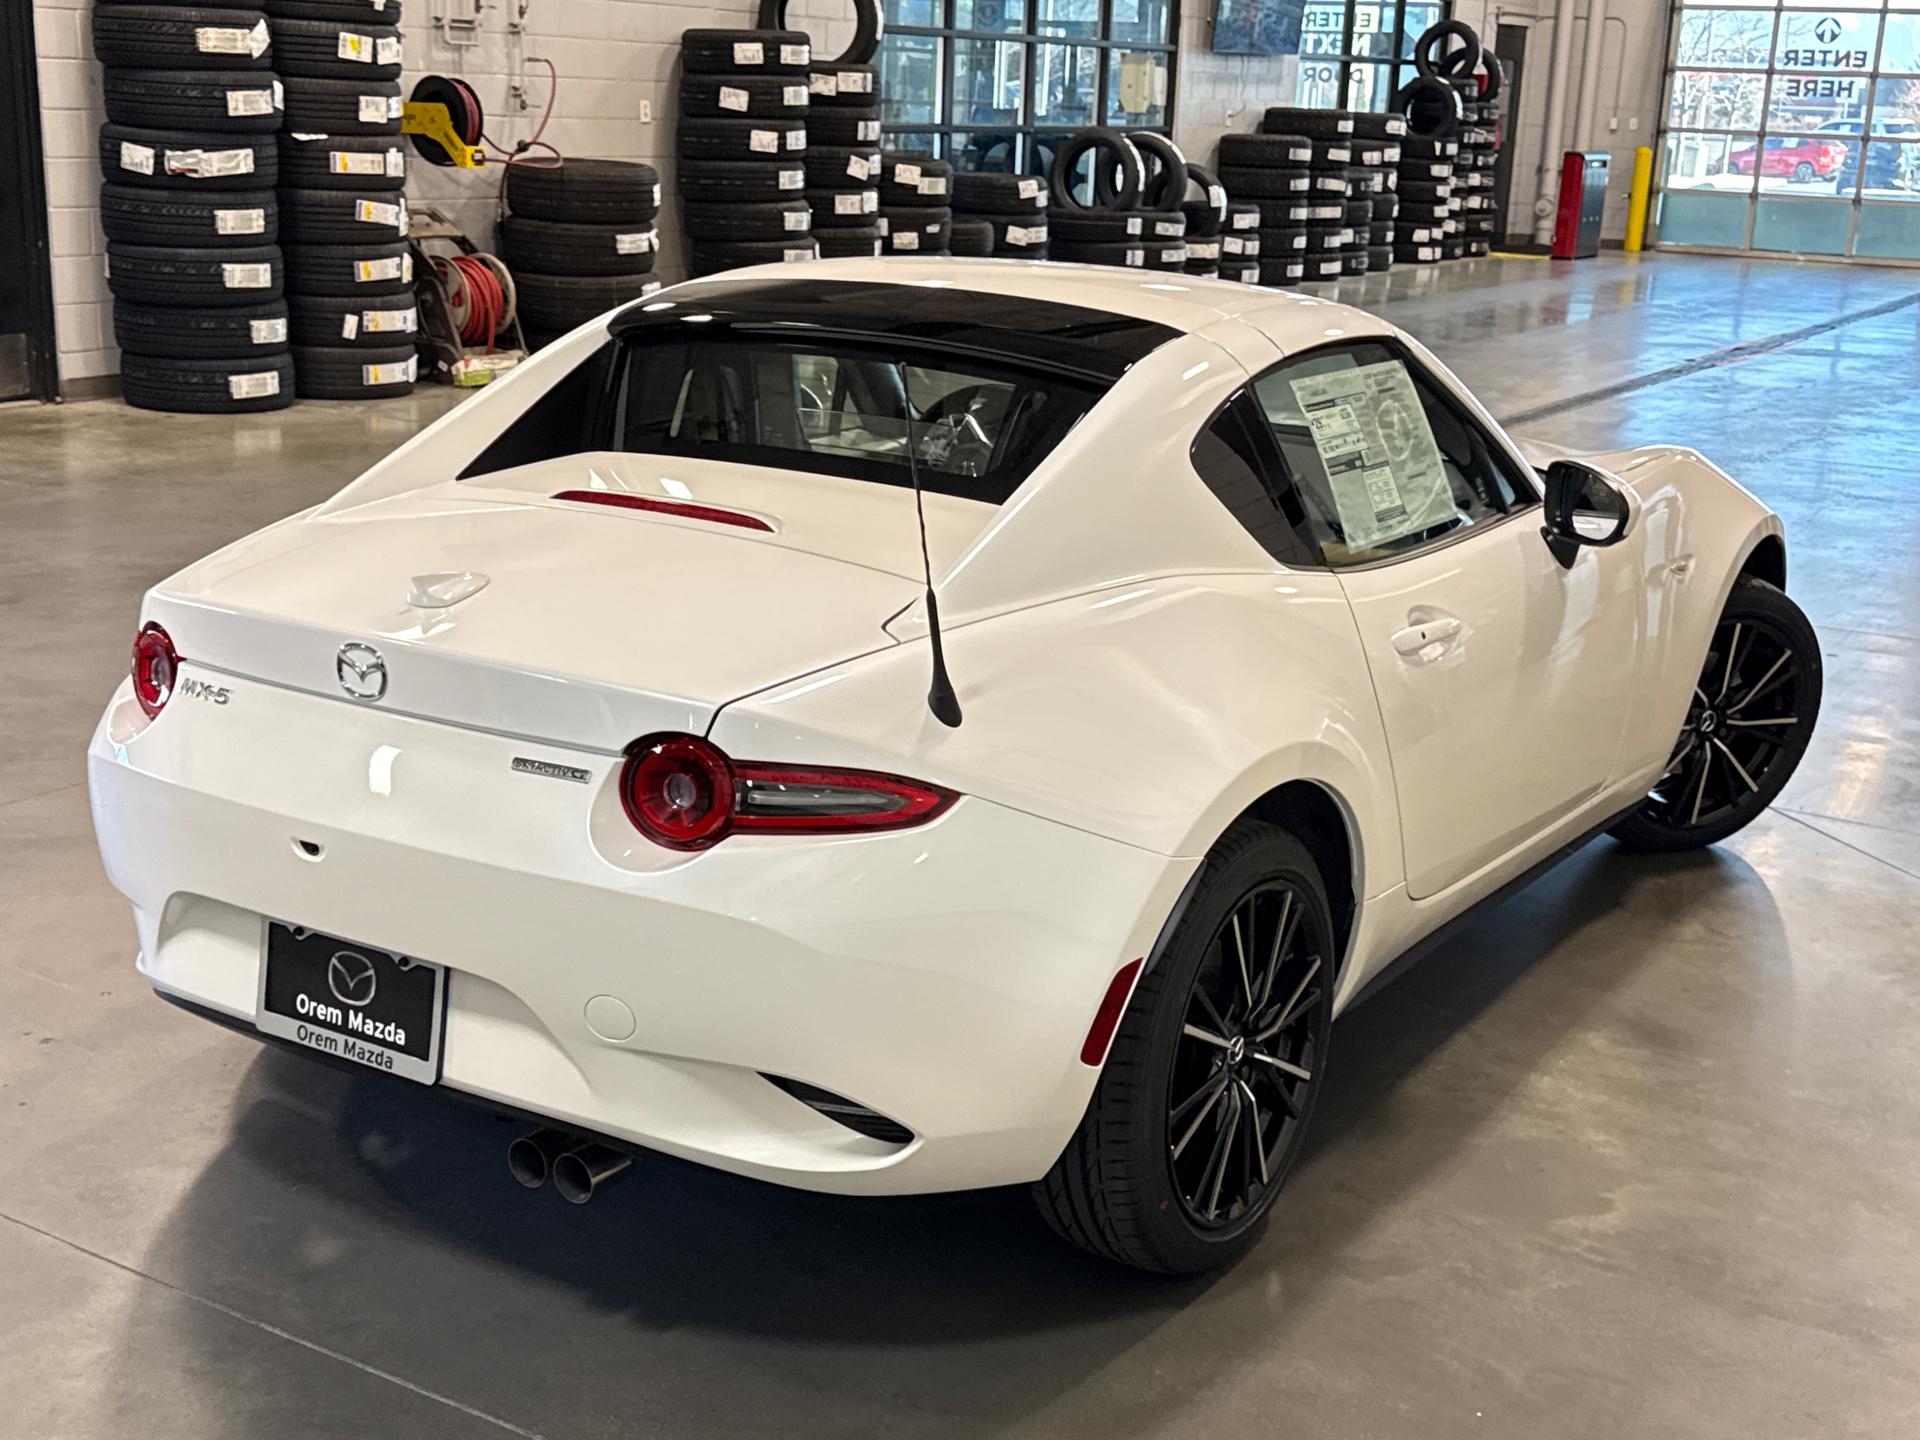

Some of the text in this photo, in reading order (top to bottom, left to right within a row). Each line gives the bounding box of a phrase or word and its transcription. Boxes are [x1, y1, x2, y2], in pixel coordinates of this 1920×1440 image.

[179, 678, 234, 705] MX-5
[295, 993, 406, 1046] Orem Mazda
[297, 1025, 394, 1070] Orem Mazda
